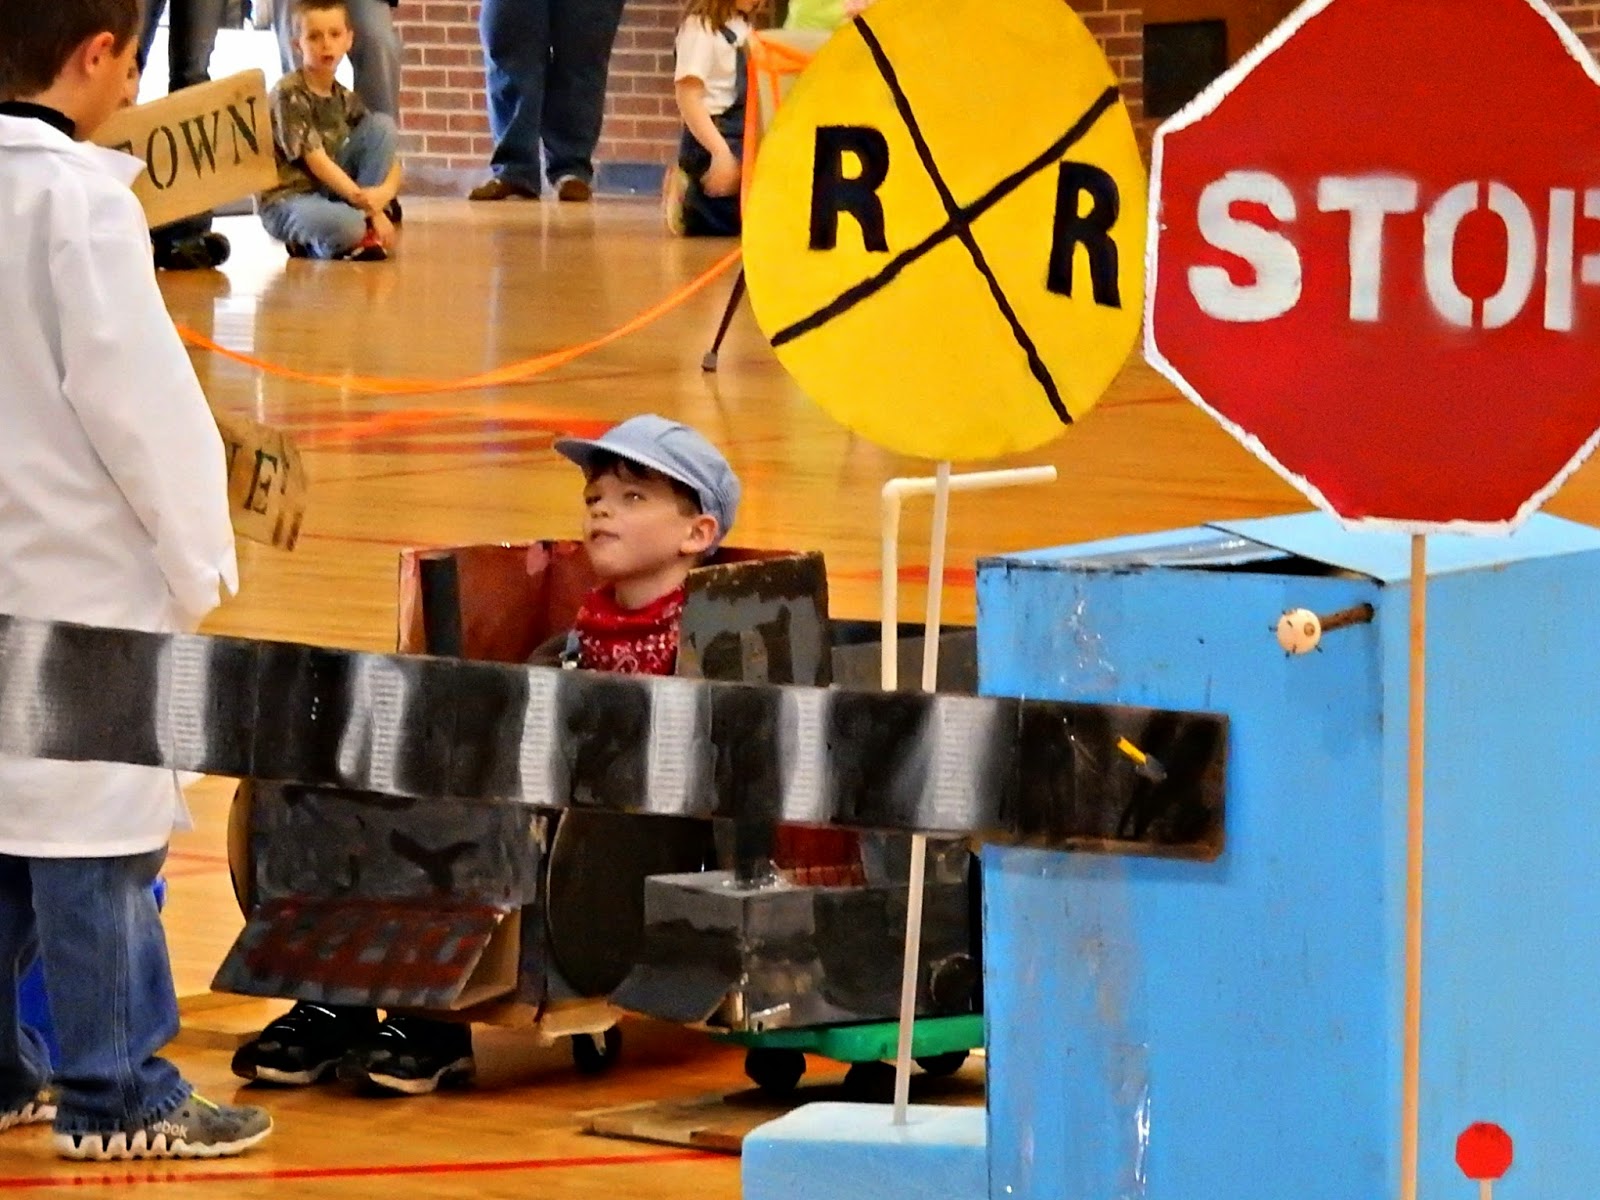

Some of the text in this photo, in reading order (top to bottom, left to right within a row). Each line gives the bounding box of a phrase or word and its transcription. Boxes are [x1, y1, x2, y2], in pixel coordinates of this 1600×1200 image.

[111, 97, 260, 190] OWN
[808, 125, 1122, 309] R R
[151, 1119, 188, 1139] ebok
